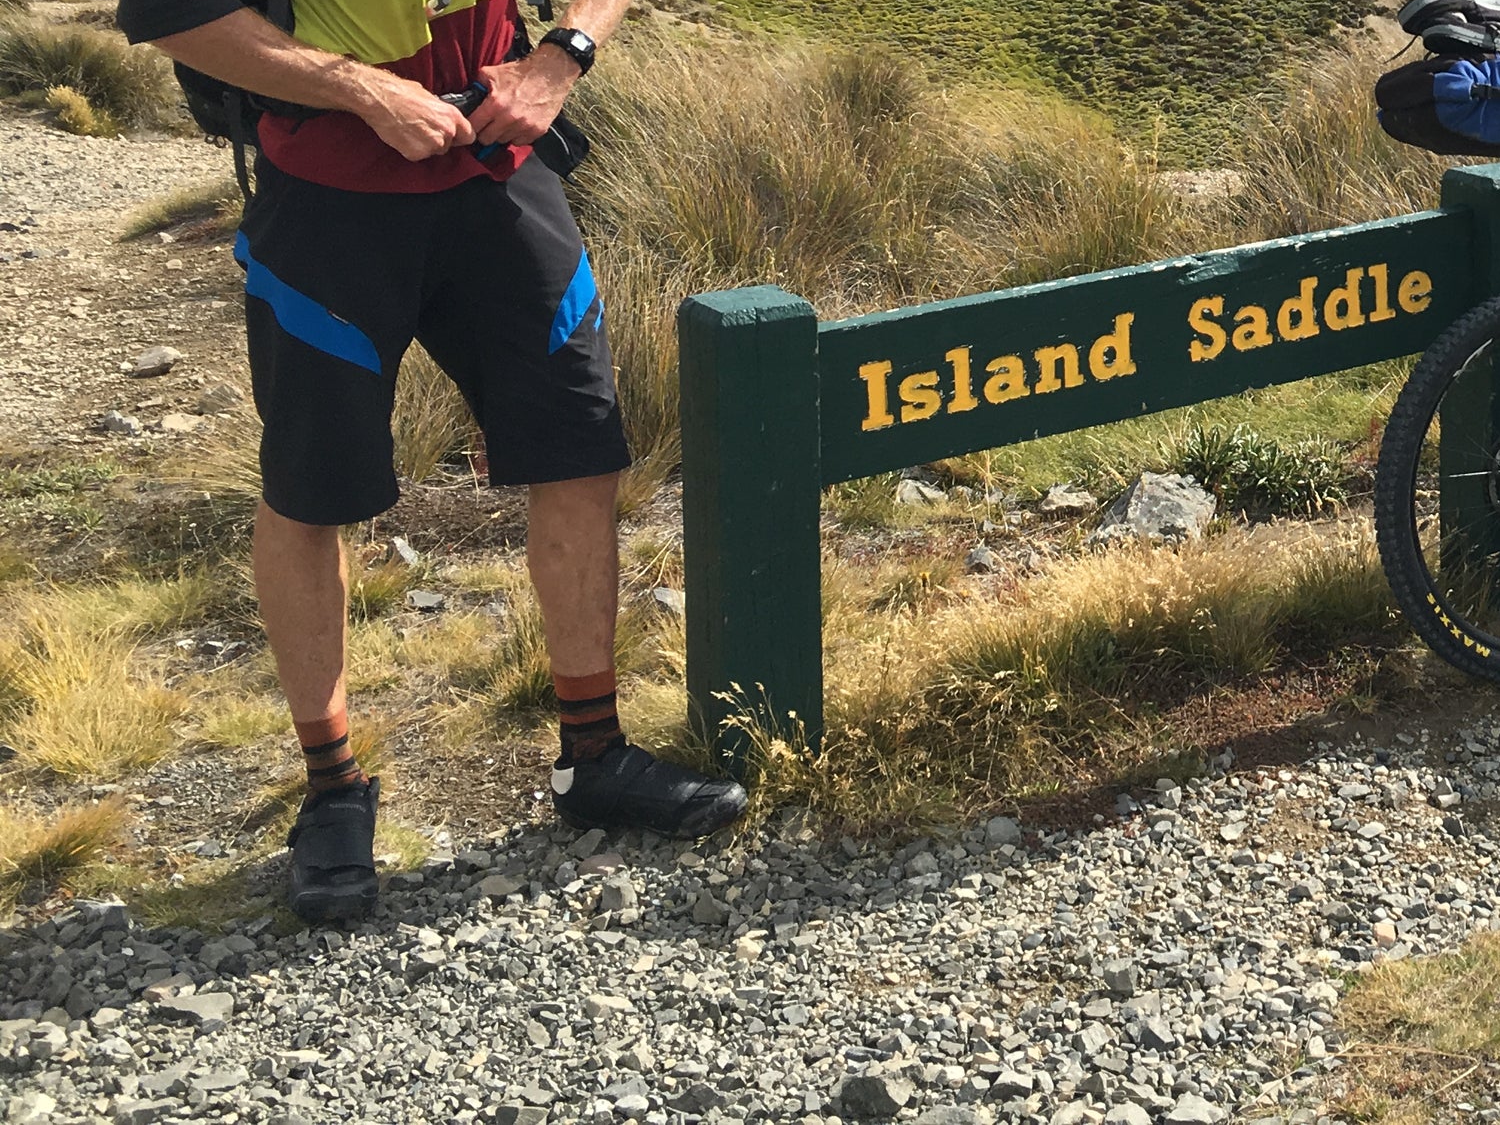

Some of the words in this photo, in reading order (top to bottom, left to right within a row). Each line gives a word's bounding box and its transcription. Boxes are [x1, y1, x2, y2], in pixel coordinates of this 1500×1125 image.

[859, 312, 1136, 431] Island
[1187, 263, 1433, 362] Saddle
[1426, 592, 1491, 658] MAXXIS
